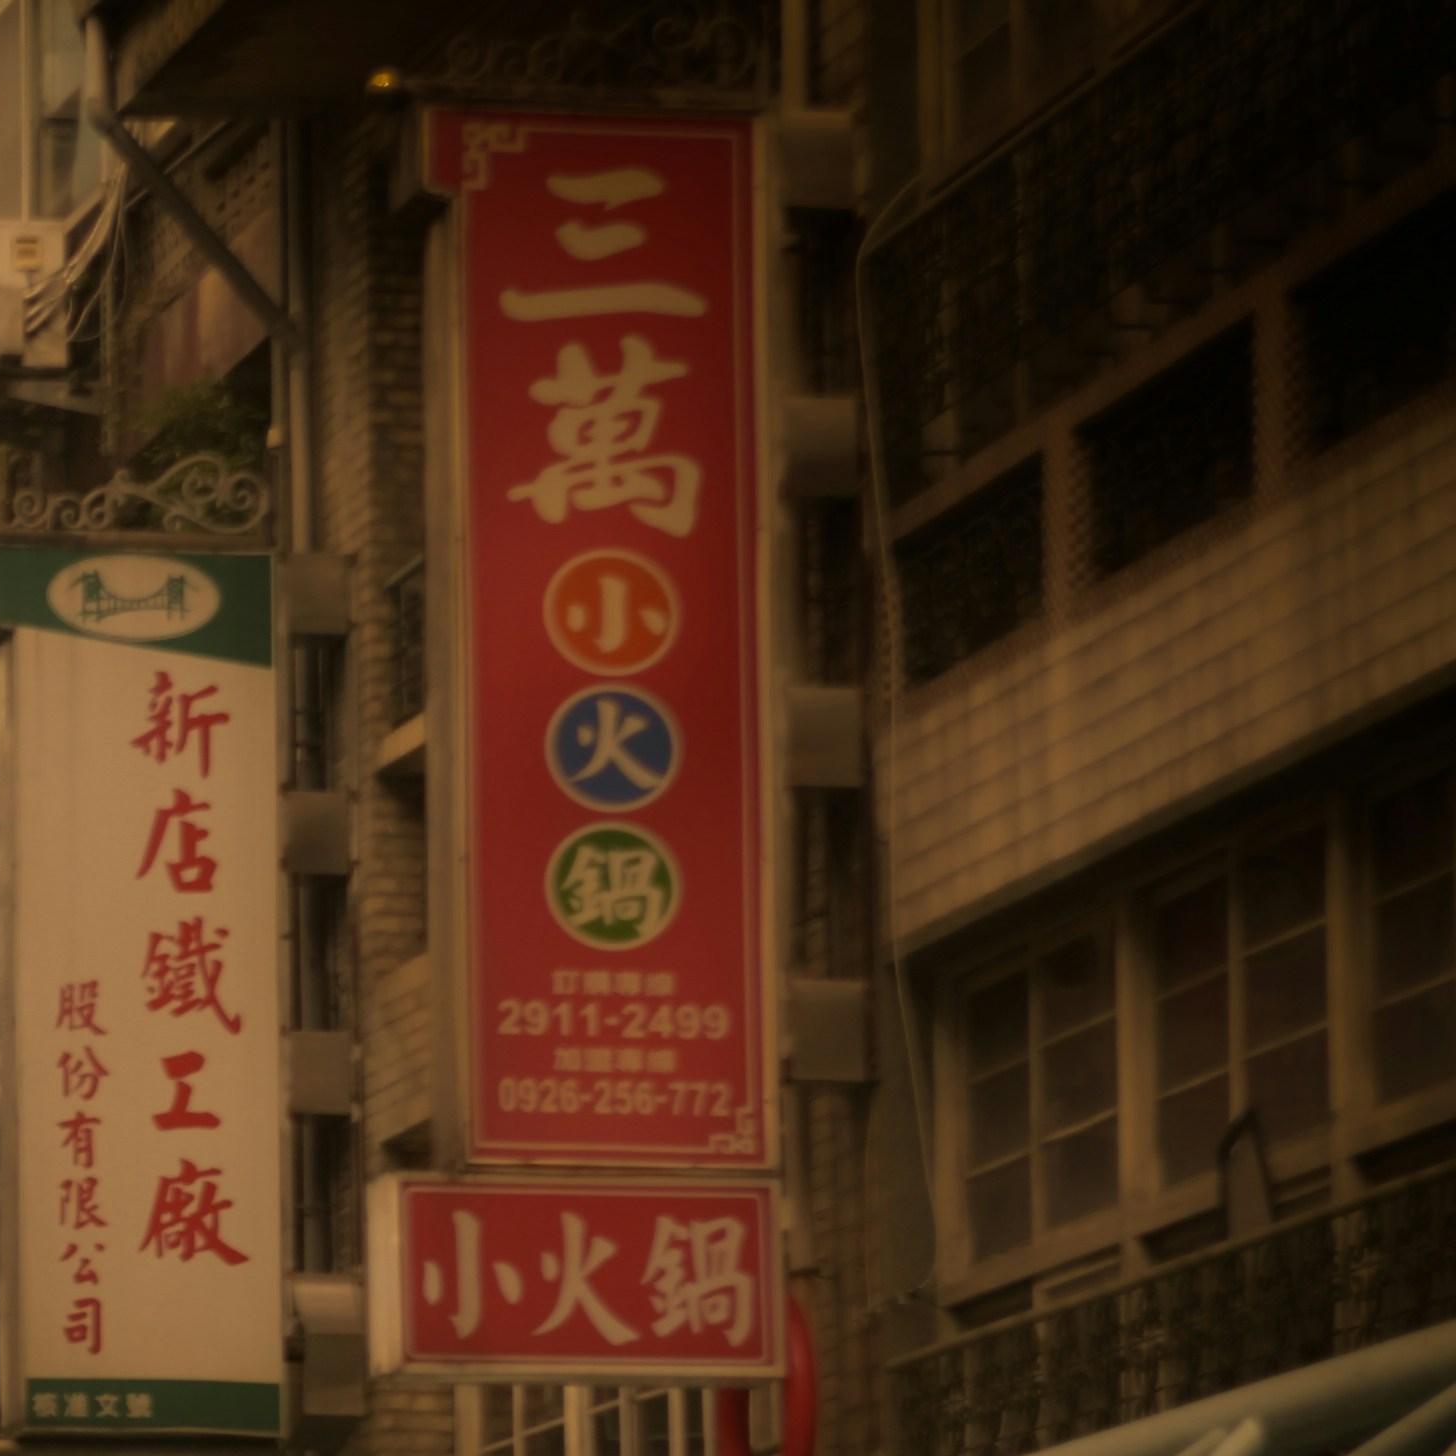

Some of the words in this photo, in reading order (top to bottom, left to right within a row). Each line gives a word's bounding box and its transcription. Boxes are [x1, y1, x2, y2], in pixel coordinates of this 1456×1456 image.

[498, 166, 710, 538] 三萬
[558, 574, 669, 936] 小火鍋
[131, 670, 248, 1267] 新店鐵工廠
[496, 998, 732, 1040] 2911-2499
[497, 1076, 733, 1117] 0926-256-772
[55, 980, 110, 1355] 股份有限公司
[422, 1209, 756, 1348] 小火鍋
